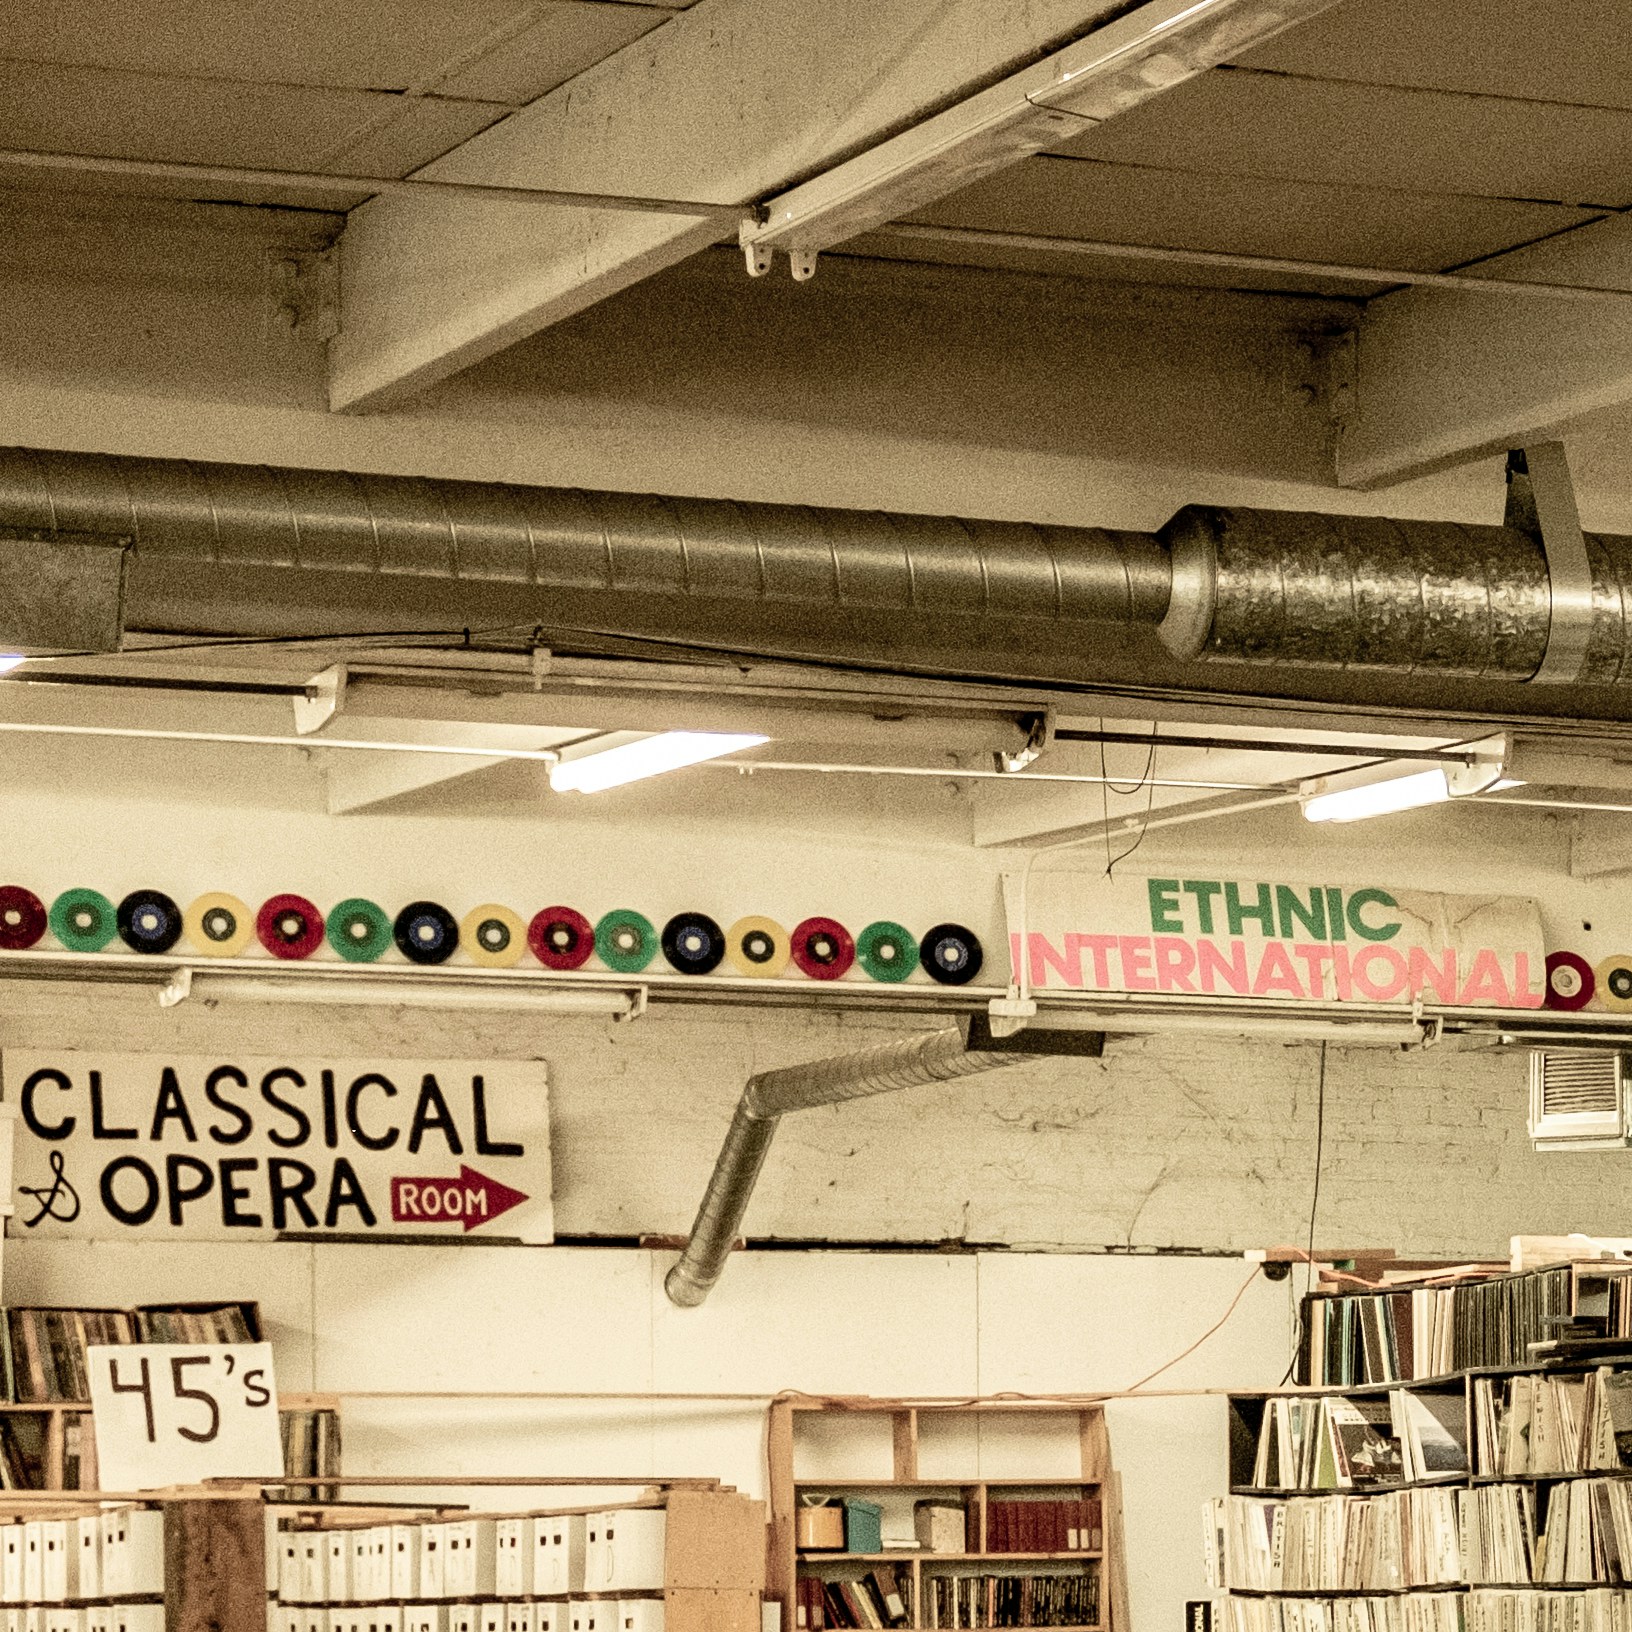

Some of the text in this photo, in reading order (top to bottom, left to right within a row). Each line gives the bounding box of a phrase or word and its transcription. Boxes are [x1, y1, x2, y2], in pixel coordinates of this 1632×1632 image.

[1147, 877, 1401, 942] ETHNIC
[1011, 932, 1546, 1009] INTERNATIONAL
[21, 1066, 524, 1156] CLASSICAL
[100, 1156, 378, 1229] OPERA
[399, 1185, 488, 1215] ROOM
